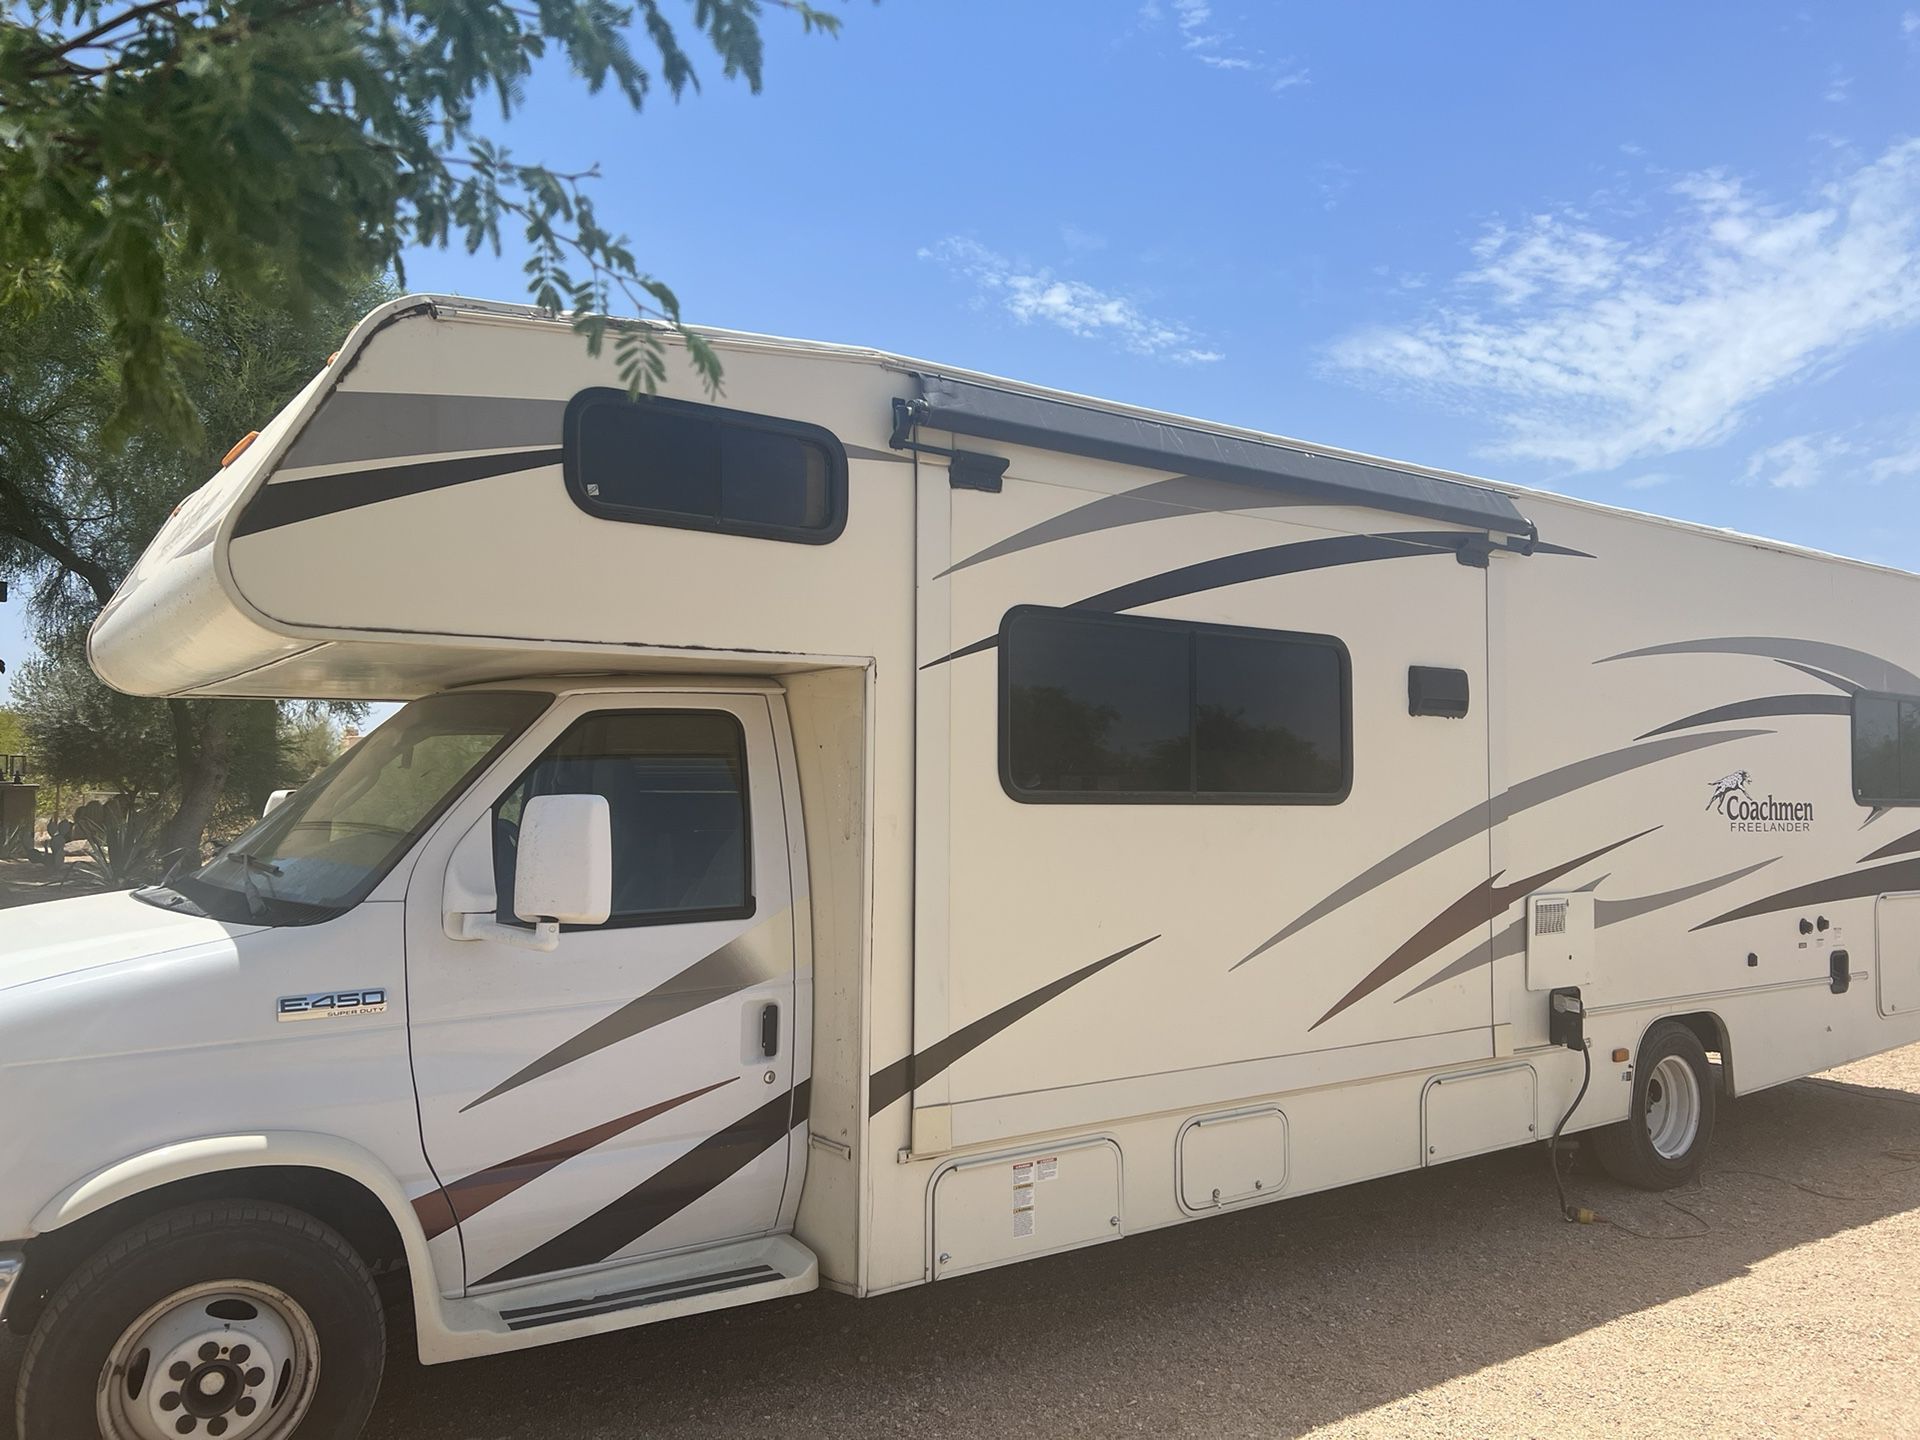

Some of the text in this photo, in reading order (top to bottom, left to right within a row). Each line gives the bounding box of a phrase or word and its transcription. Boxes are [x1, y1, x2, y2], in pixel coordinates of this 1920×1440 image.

[1726, 794, 1814, 821] Coachmen
[1730, 822, 1810, 832] FREELANDER
[280, 990, 385, 1013] E-450
[327, 1006, 384, 1017] SUPER DUTY
